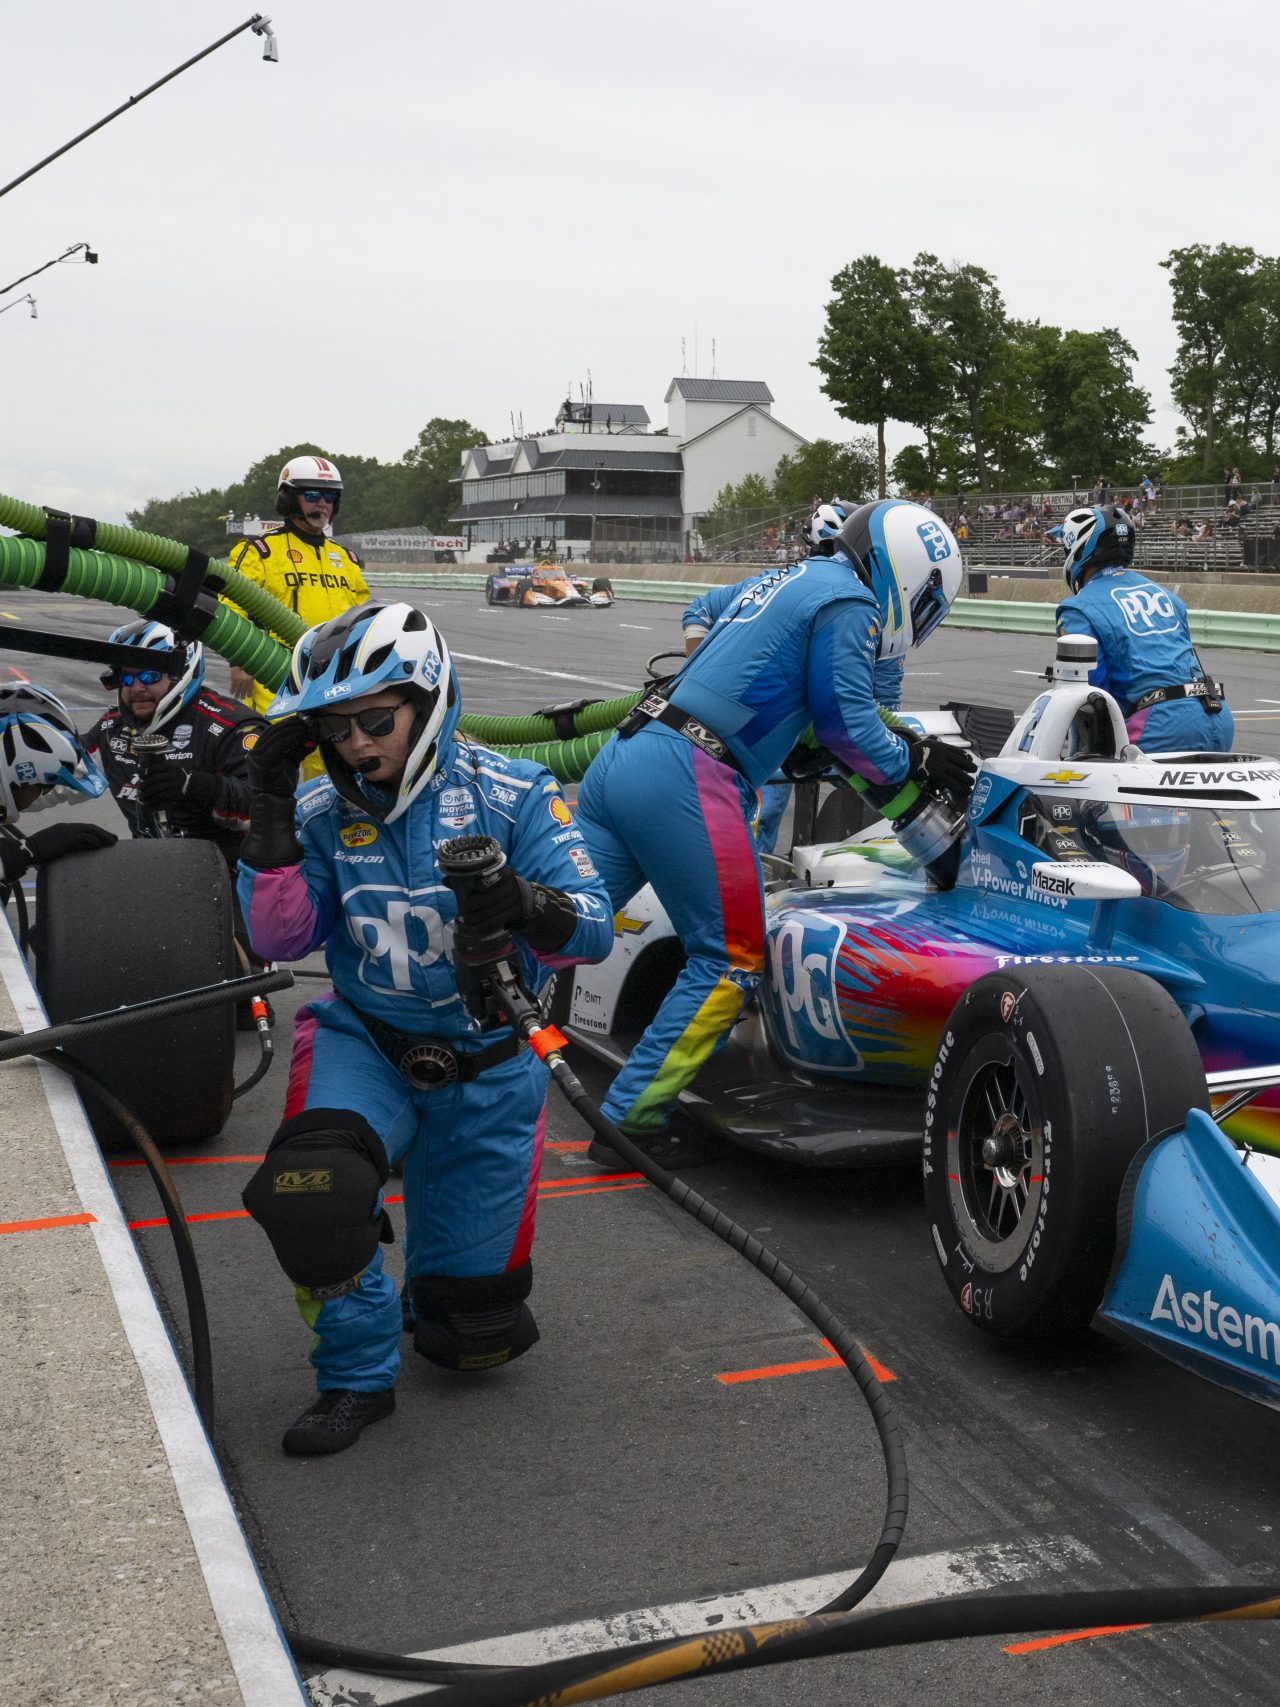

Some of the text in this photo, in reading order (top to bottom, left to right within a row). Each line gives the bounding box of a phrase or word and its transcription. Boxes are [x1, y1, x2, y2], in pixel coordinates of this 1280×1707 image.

[364, 537, 467, 550] WeatherTech
[921, 522, 948, 561] PPG
[1119, 589, 1175, 628] PPG
[326, 683, 351, 698] PPG
[164, 752, 194, 761] verizon
[490, 786, 517, 803] OMP
[1054, 805, 1072, 820] PPG
[333, 850, 385, 865] Snap-on
[970, 848, 991, 866] Shell
[971, 866, 1025, 897] V-Power
[1031, 868, 1076, 896] Mazak
[993, 955, 1140, 969] Firestone
[574, 1013, 608, 1031] Firestone
[923, 1030, 955, 1179] Firestone
[1019, 1120, 1053, 1283] Firestone
